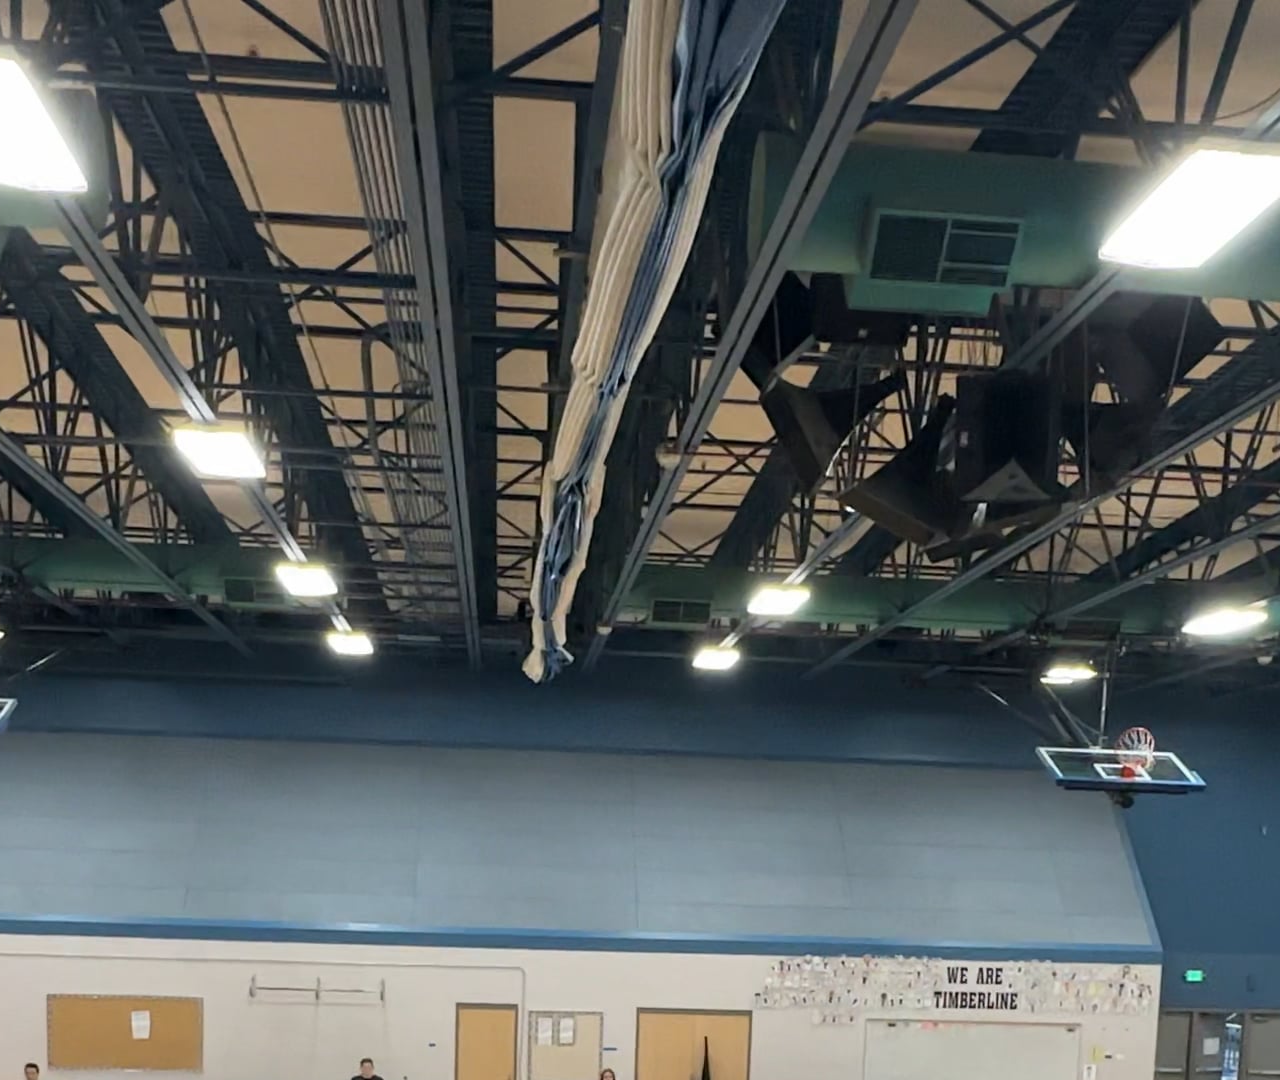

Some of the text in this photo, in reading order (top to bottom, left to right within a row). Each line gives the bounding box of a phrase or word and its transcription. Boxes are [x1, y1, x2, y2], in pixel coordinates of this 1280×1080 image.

[947, 966, 1003, 984] WE ARE
[933, 991, 1018, 1010] TIMBERLINE
